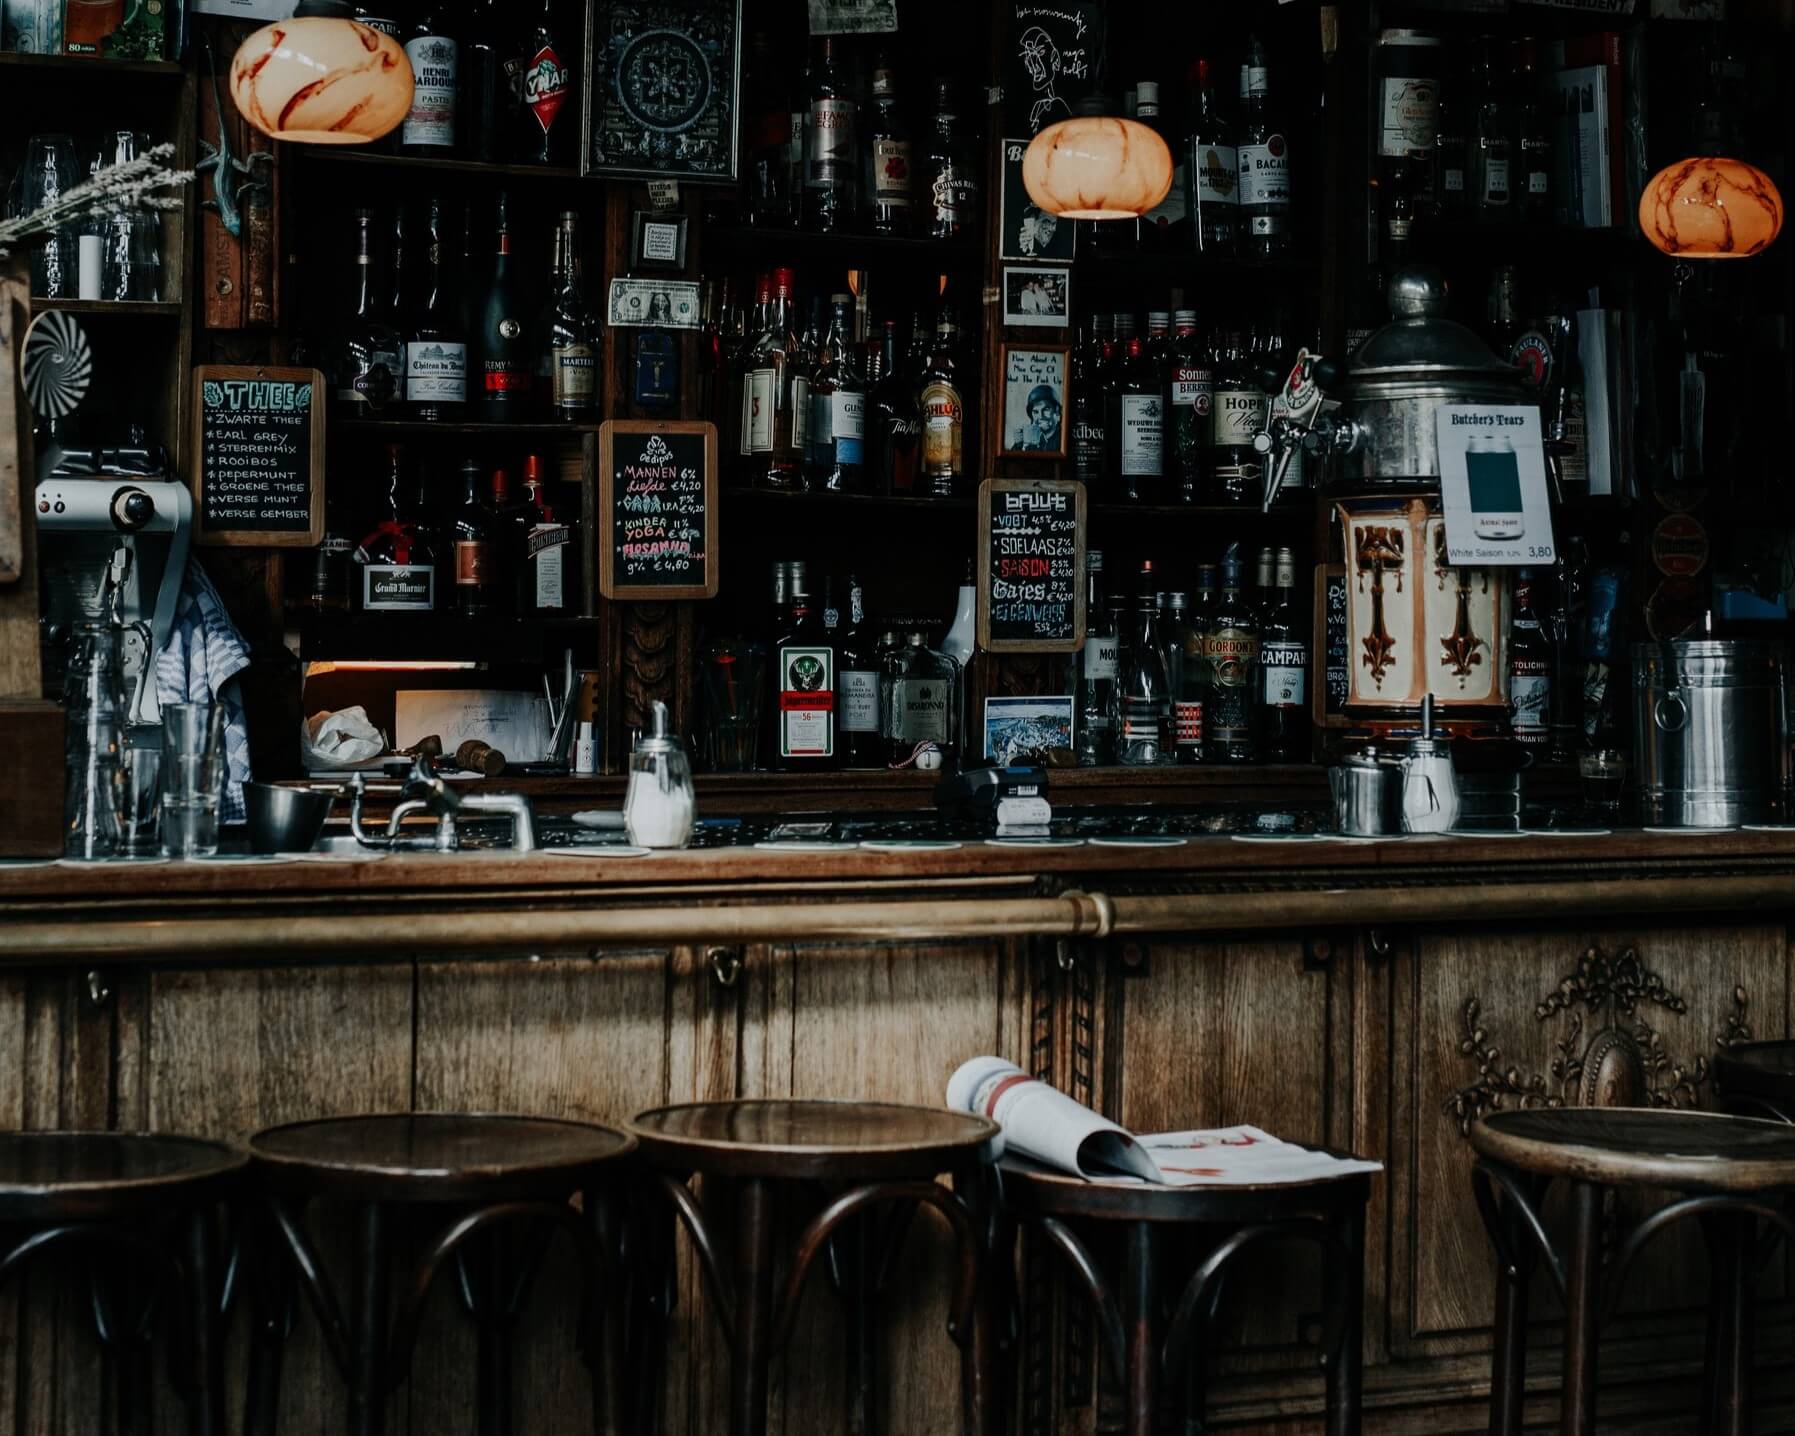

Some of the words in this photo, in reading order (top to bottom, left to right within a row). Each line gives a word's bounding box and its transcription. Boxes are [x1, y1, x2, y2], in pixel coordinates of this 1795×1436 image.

[422, 67, 449, 77] HENRI
[958, 192, 967, 200] 12
[223, 381, 296, 410] THEE
[1225, 398, 1264, 411] HOPP
[215, 413, 267, 425] ZWARTE
[273, 415, 303, 425] THEE
[1451, 413, 1494, 426] Butcher's
[1496, 414, 1525, 426] Tears
[215, 430, 248, 440] EARL
[254, 431, 288, 446] GREY
[624, 465, 677, 479] MANNEN
[219, 482, 270, 492] GROENE
[274, 483, 305, 492] THEE
[218, 495, 259, 504] VERSE
[264, 495, 299, 504] MUNT
[217, 510, 257, 519] VERSE
[260, 510, 309, 519] GEMBER
[624, 516, 668, 530] KINDER
[624, 526, 666, 542] YOGA
[1000, 537, 1056, 556] SOELAAS
[1449, 548, 1474, 558] White
[1475, 547, 1504, 558] Saison
[1528, 546, 1553, 559] 3,80
[802, 712, 812, 721] 56
